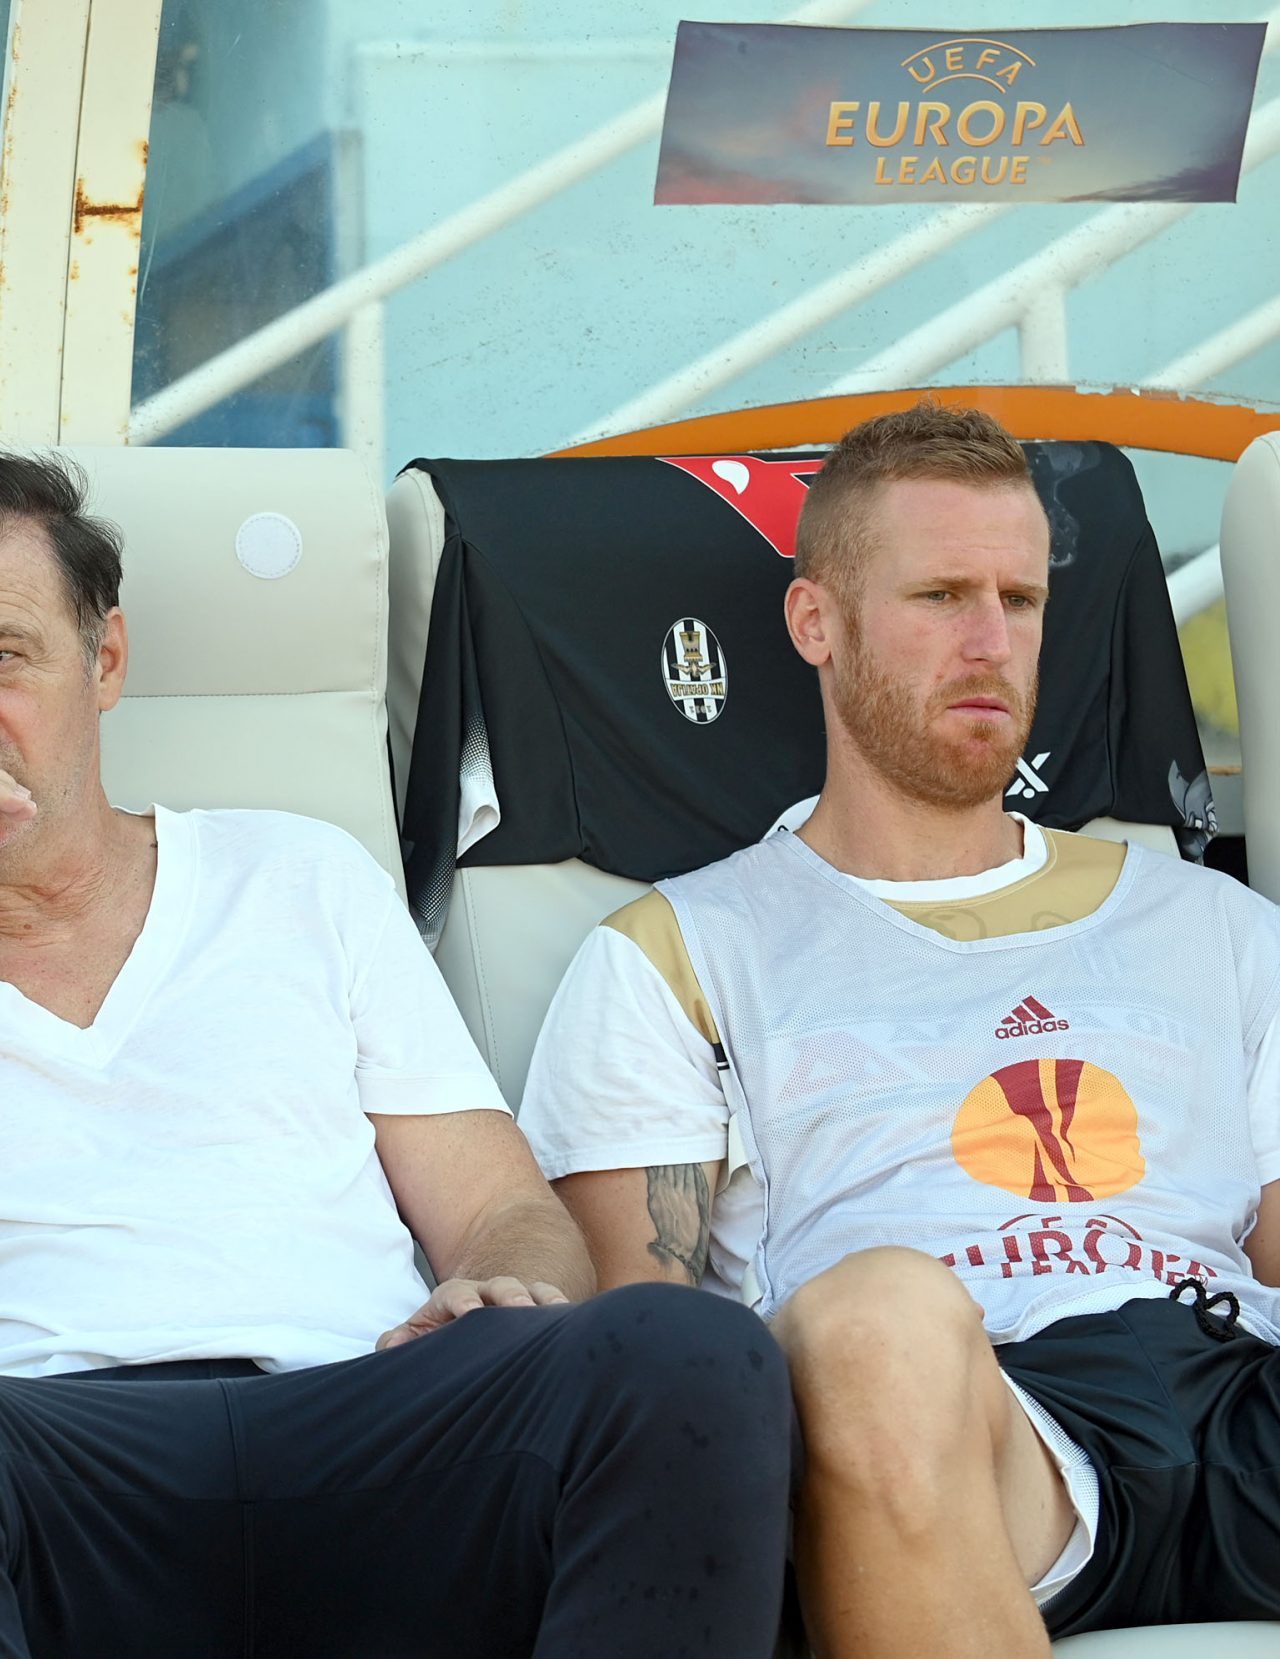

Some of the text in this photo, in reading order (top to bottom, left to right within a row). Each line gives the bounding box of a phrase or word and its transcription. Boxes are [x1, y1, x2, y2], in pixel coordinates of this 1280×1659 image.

[908, 47, 1022, 85] UEFA
[825, 101, 1085, 148] EUROPA
[874, 156, 1030, 186] LEAGUE
[710, 681, 725, 696] NK
[994, 1019, 1070, 1040] adidas
